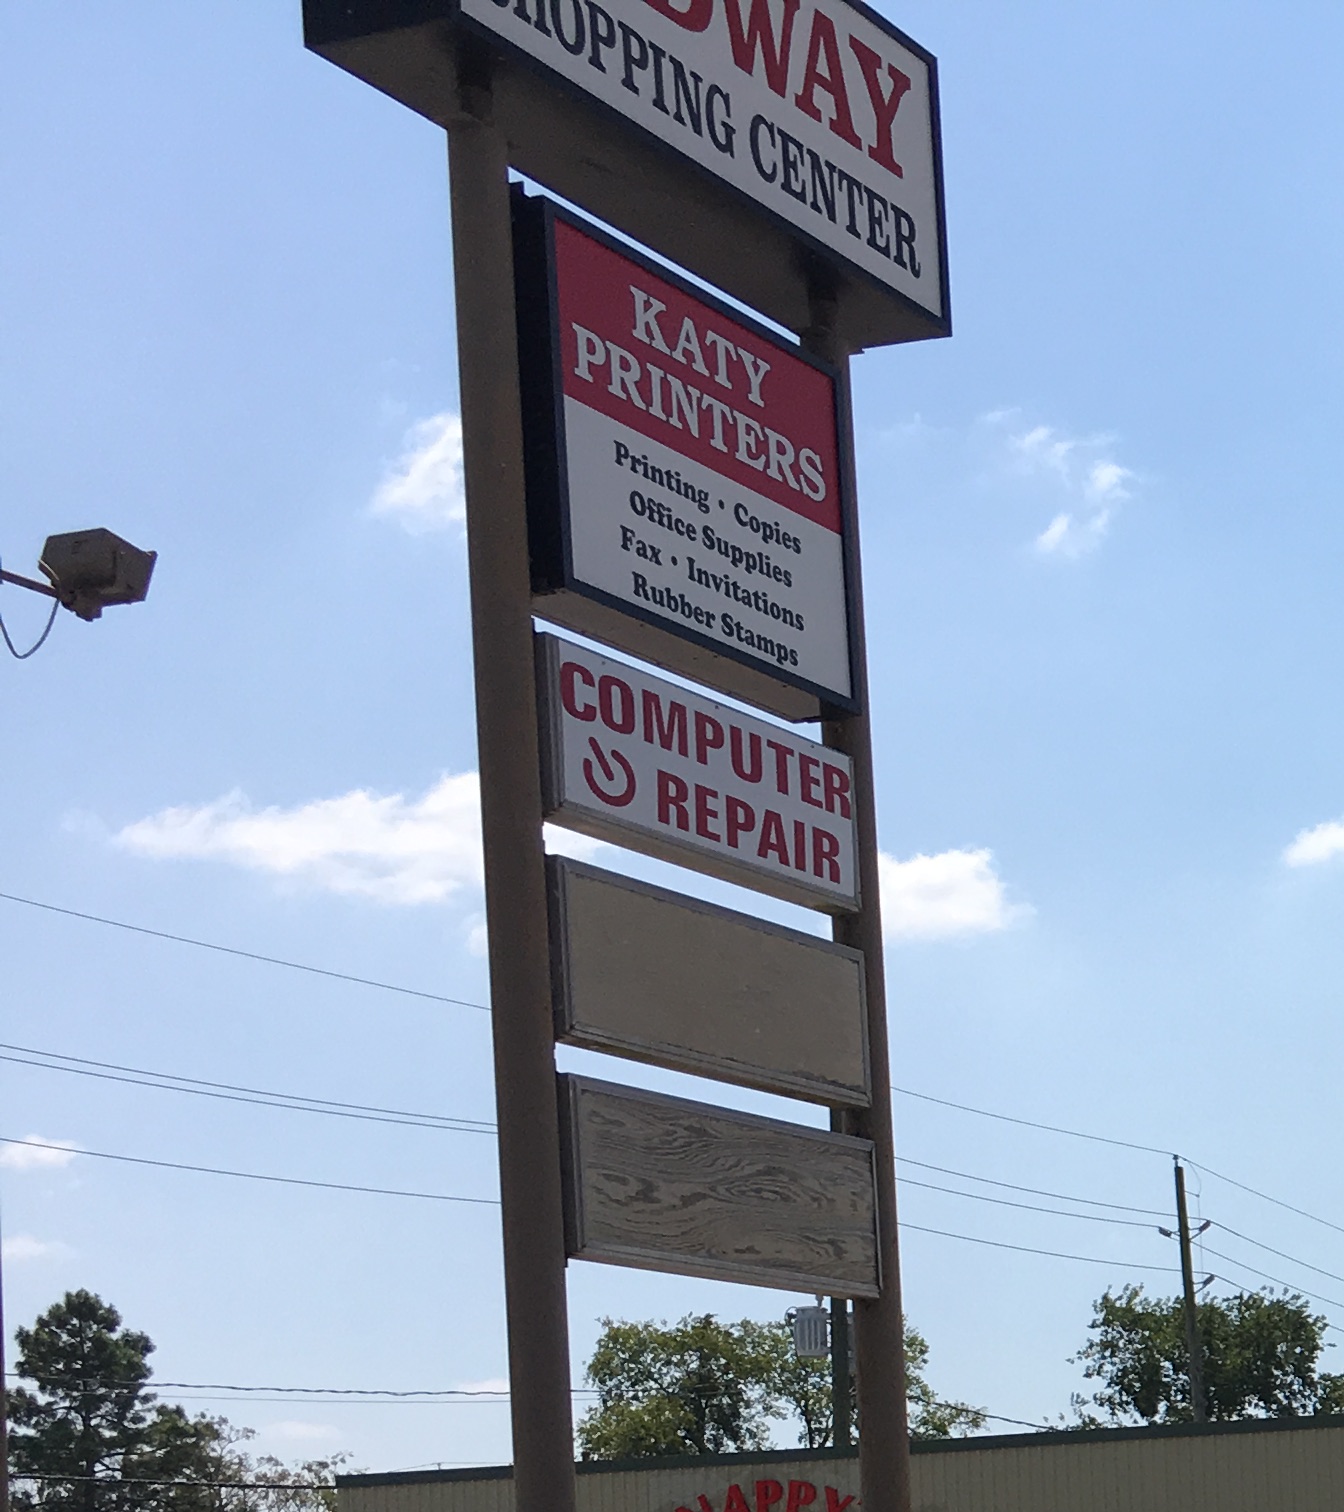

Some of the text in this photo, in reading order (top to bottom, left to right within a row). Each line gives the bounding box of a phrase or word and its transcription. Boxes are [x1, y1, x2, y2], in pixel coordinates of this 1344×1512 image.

[491, 0, 920, 278] OPPING CENTER
[630, 285, 770, 407] KATY
[572, 323, 826, 501] PRINTERS
[614, 440, 801, 555] Printing Copies
[630, 491, 792, 588] Office Supplies
[620, 526, 805, 631] Fax Invitations
[632, 572, 799, 667] Rubber Stamps
[560, 661, 851, 820] COMPUTER
[657, 769, 841, 884] REPAIR
